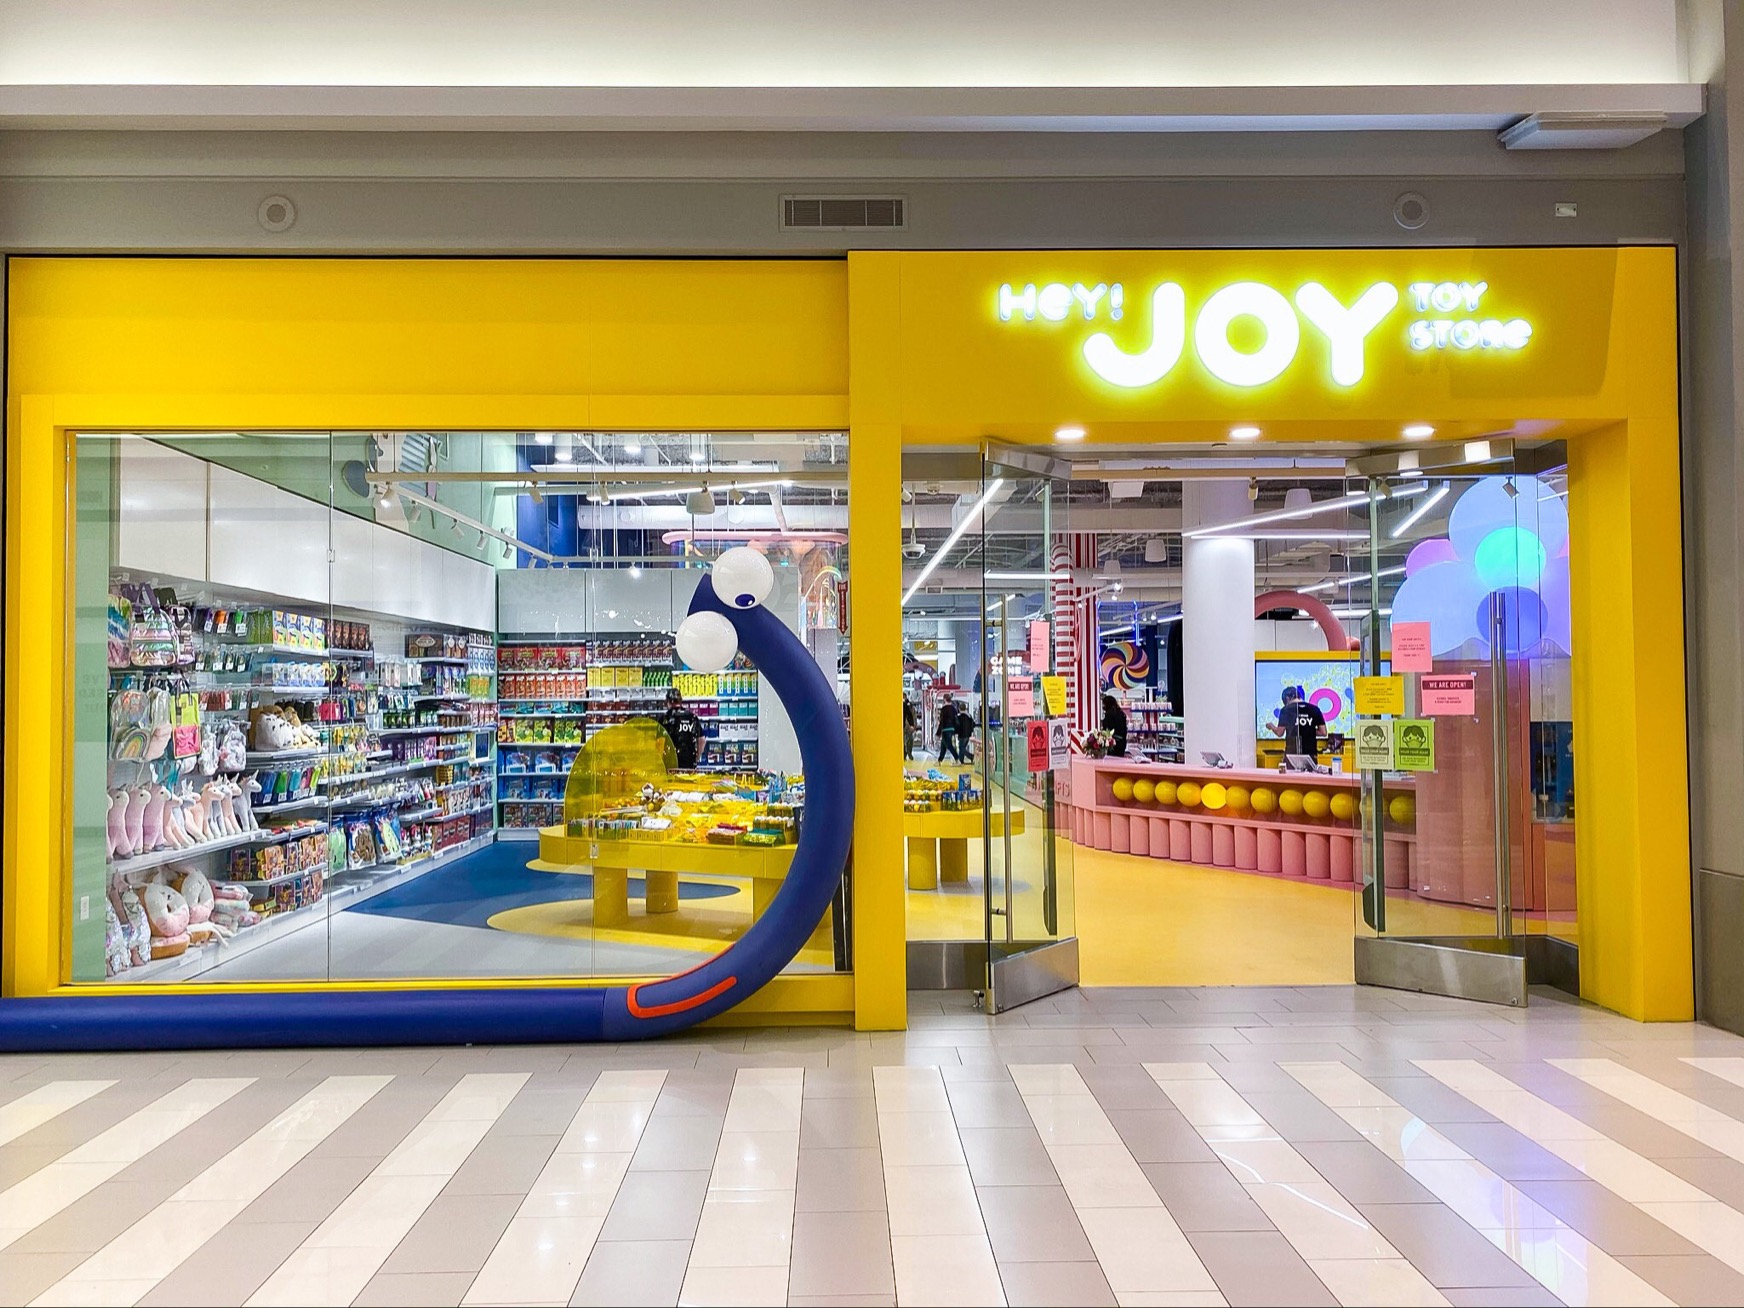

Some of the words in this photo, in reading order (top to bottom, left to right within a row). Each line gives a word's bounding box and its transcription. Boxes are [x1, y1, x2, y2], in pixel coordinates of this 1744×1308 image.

[1409, 281, 1488, 313] TOY
[1082, 281, 1399, 387] JOY
[679, 723, 694, 732] JOY
[1295, 718, 1313, 726] JOY
